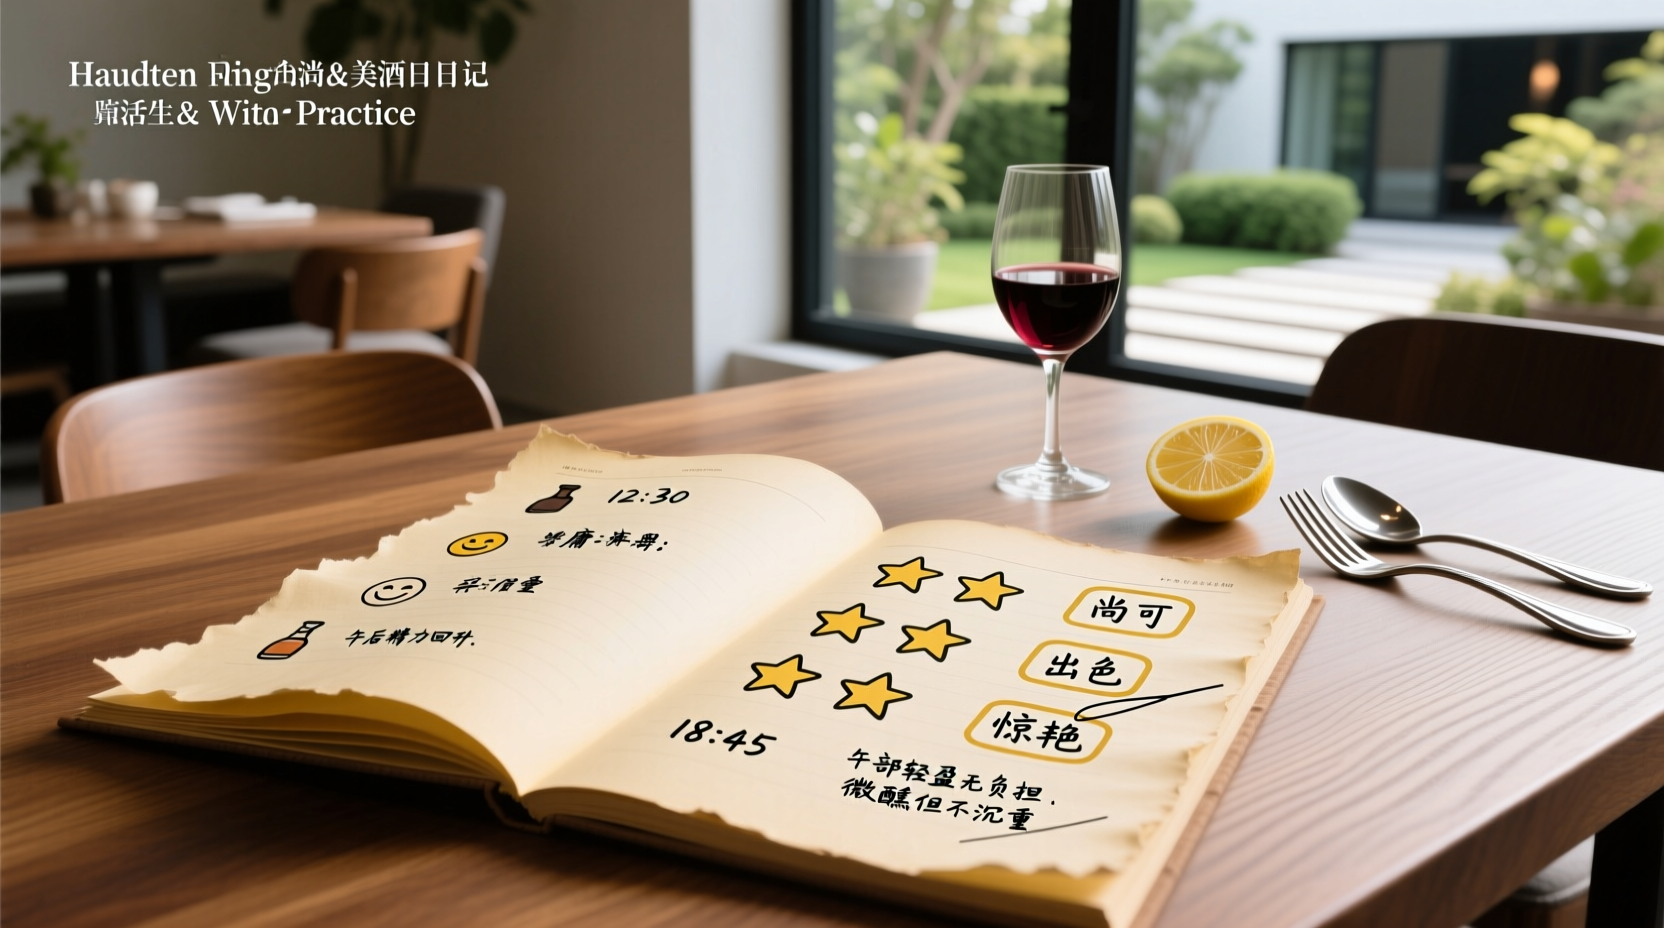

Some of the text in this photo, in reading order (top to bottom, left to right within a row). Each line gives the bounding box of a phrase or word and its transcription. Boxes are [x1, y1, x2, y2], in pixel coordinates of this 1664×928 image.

[608, 487, 690, 505] 12:30
[1091, 595, 1173, 629] 尚可
[1045, 652, 1122, 686] 出色
[670, 718, 777, 756] 18:45
[992, 711, 1083, 753] 惊艳
